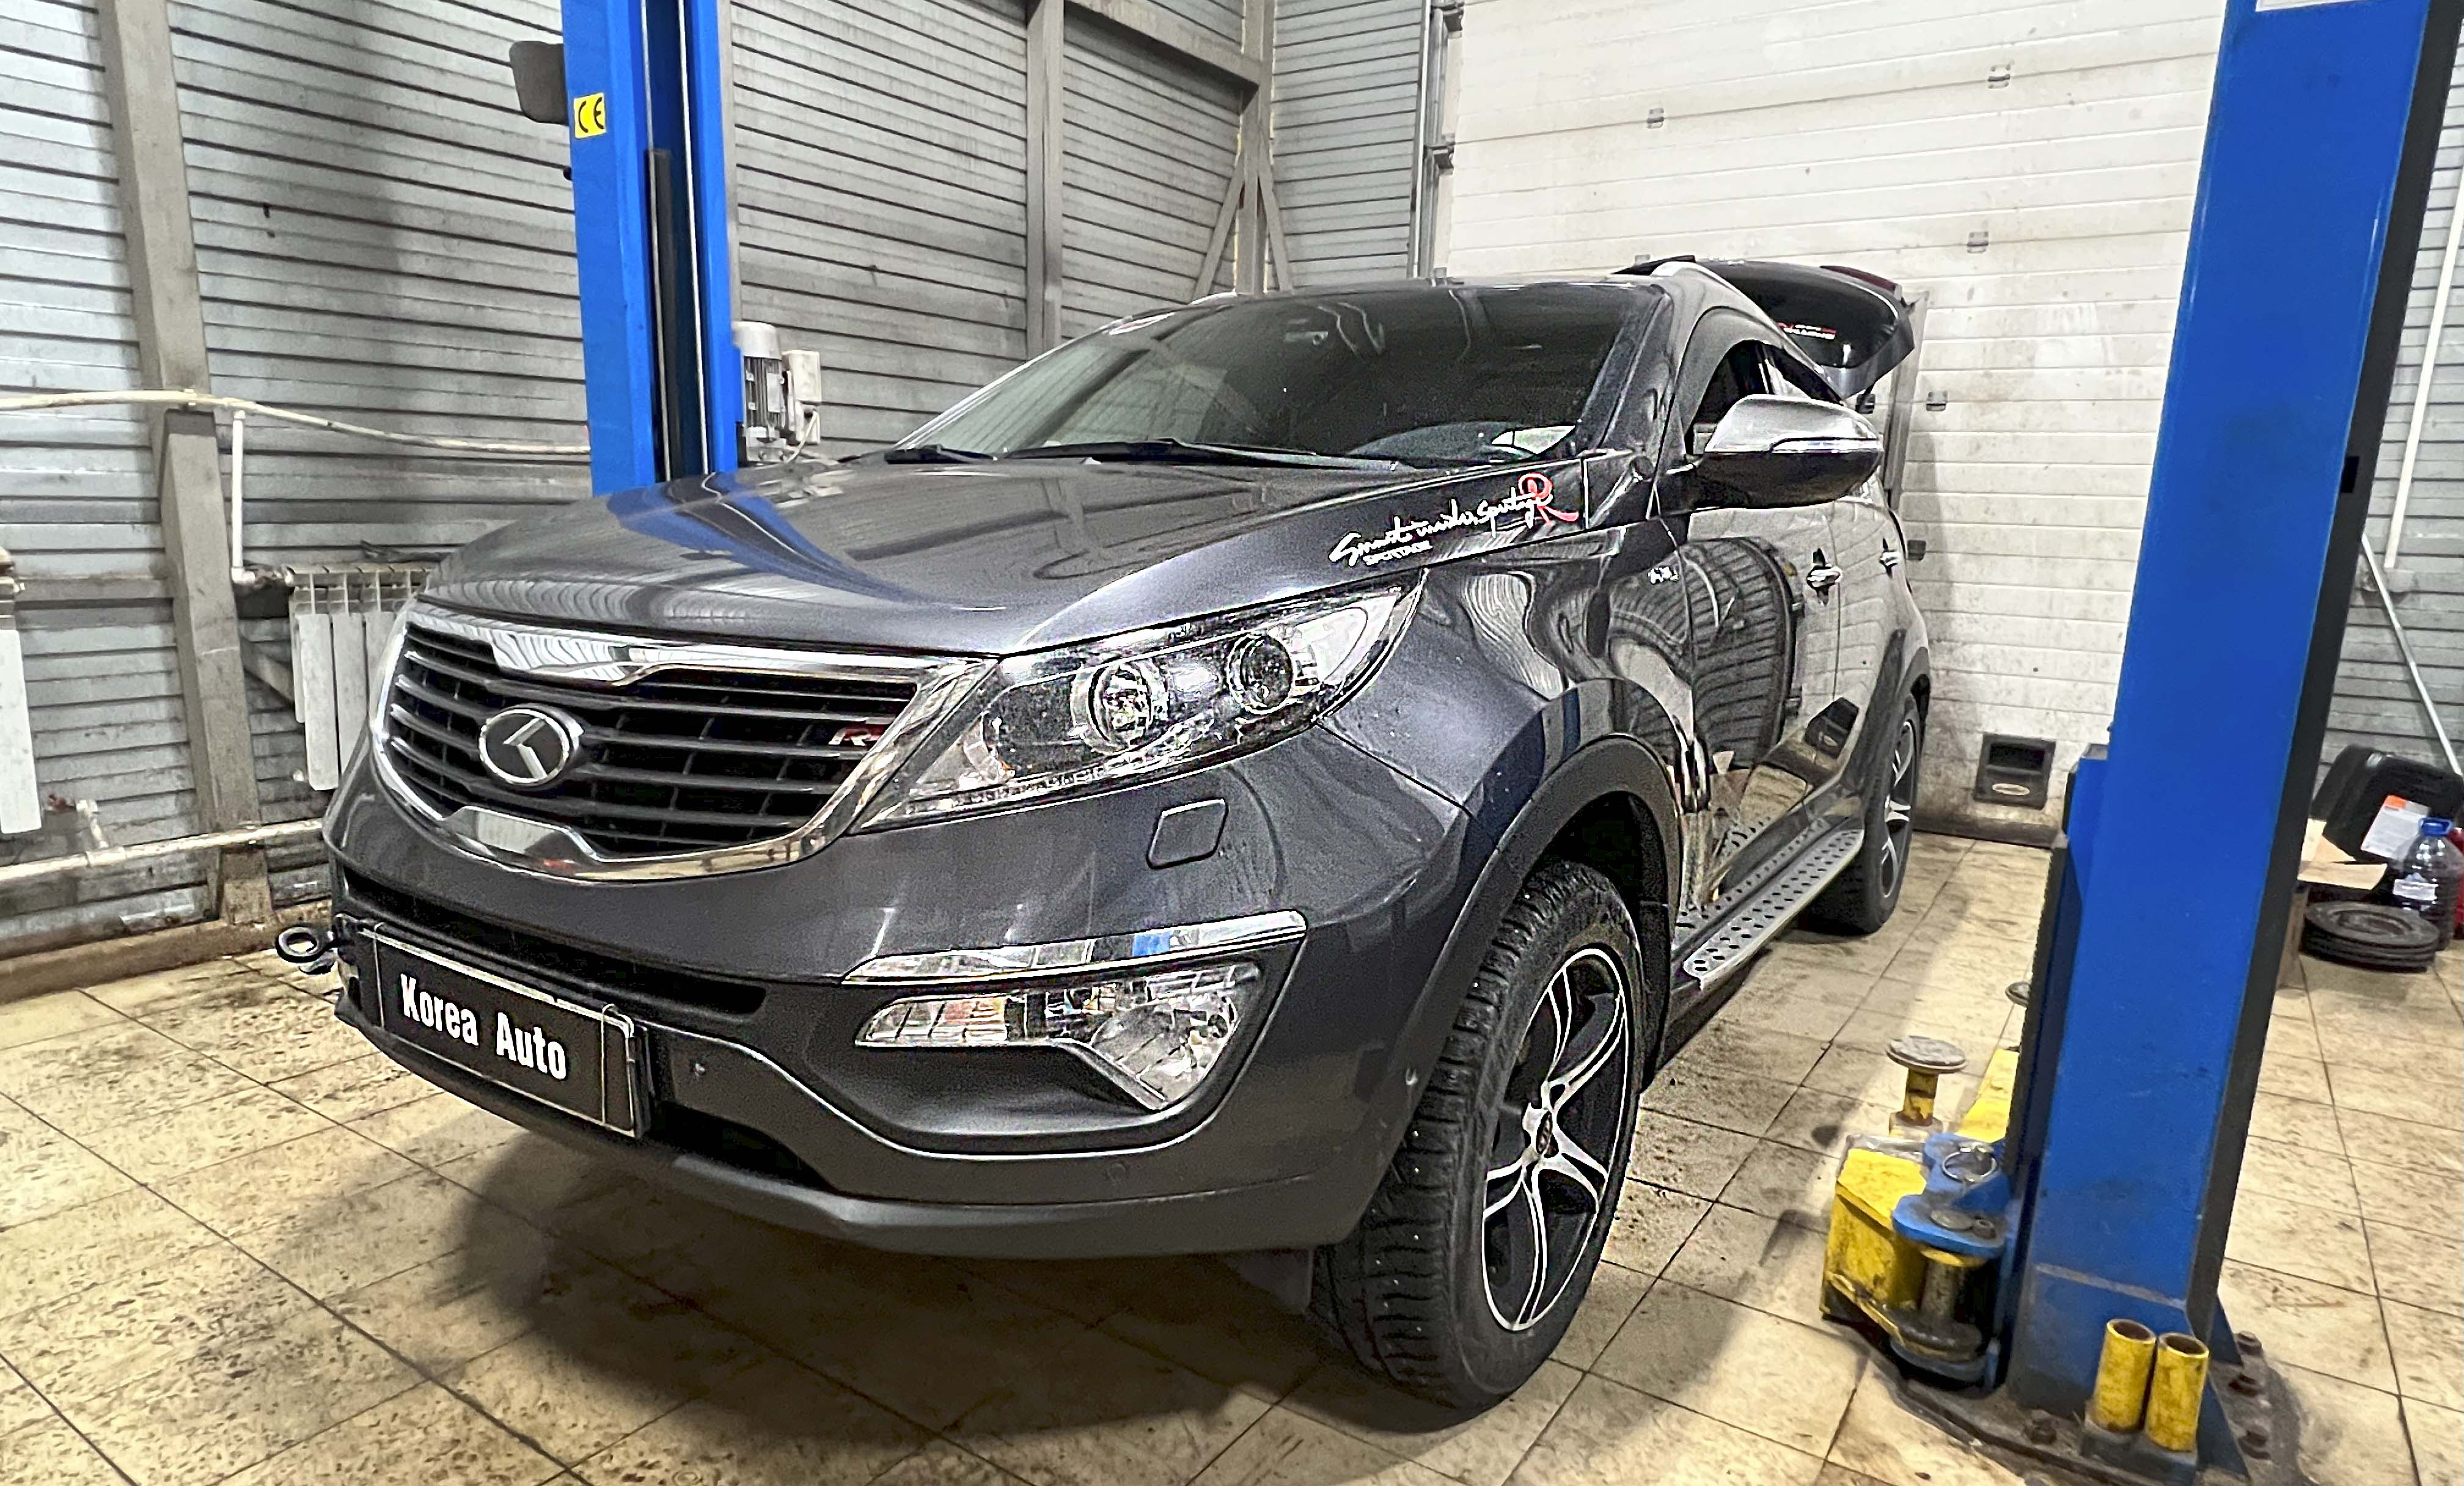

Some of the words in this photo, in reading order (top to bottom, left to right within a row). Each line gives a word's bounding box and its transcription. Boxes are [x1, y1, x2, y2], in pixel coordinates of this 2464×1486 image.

[578, 97, 605, 133] CE
[400, 973, 479, 1047] Korea
[496, 1011, 567, 1080] Auto
